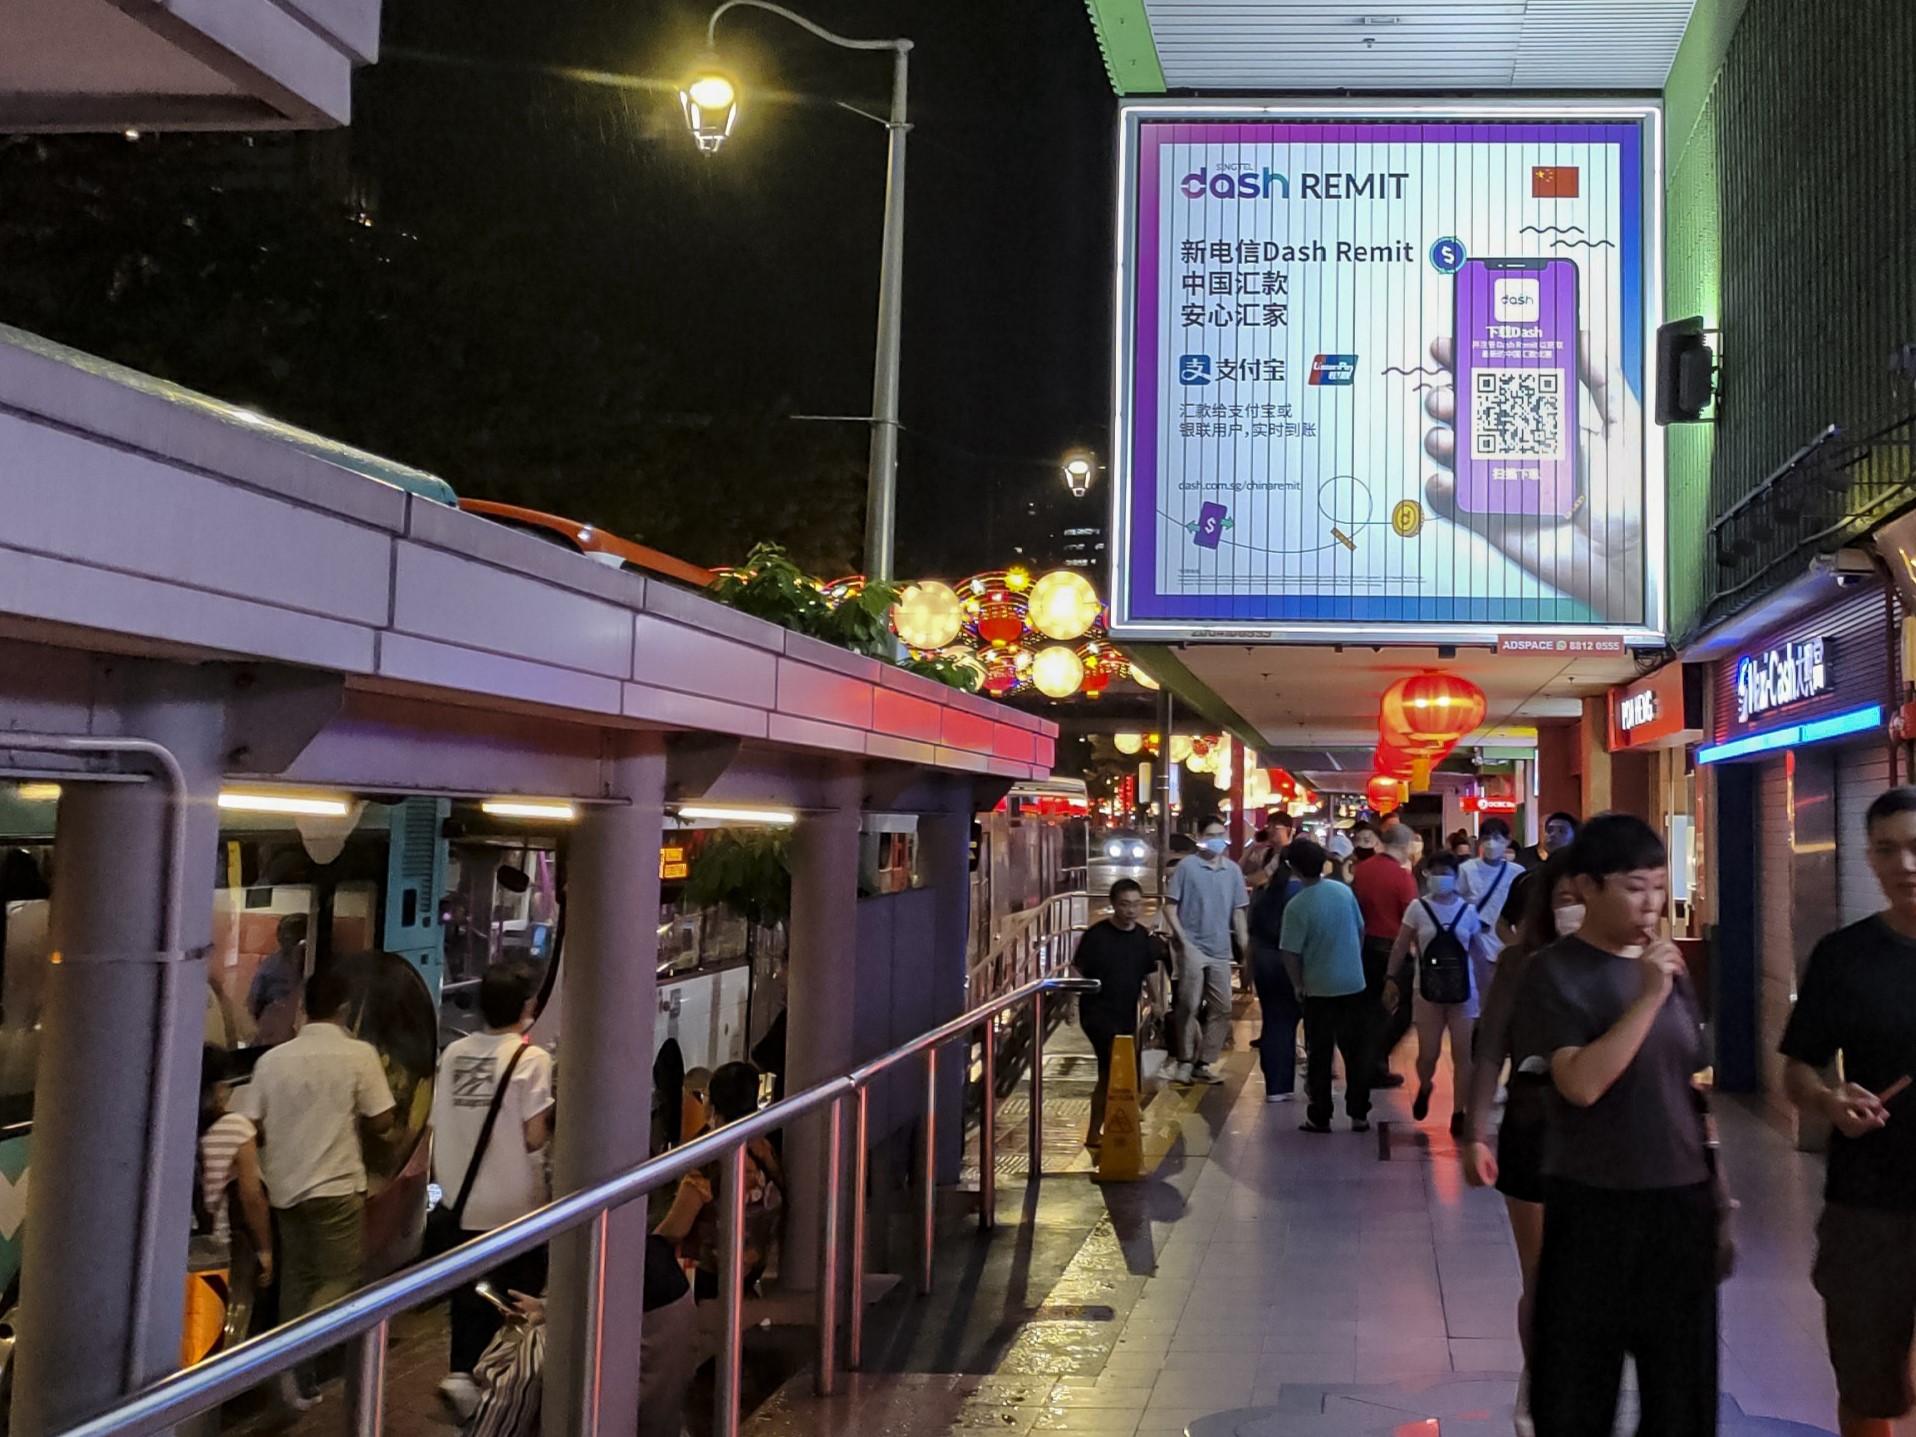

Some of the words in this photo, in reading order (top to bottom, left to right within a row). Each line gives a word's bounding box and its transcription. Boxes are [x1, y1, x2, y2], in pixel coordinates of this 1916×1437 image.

[1180, 167, 1289, 199] dash
[1301, 173, 1409, 200] REMIT
[1180, 239, 1327, 264] 新电信Dash
[1336, 240, 1414, 263] Remit
[1181, 270, 1288, 296] 中国汇款
[1180, 302, 1288, 328] 安心汇家
[1215, 358, 1285, 382] 支付宝
[1179, 403, 1293, 419] 汇款给支付宝或
[1178, 480, 1301, 492] dash.com.sg/chinaremit
[1502, 640, 1553, 650] ADSPACE
[1569, 641, 1593, 650] 8812
[1595, 641, 1620, 650] 0555
